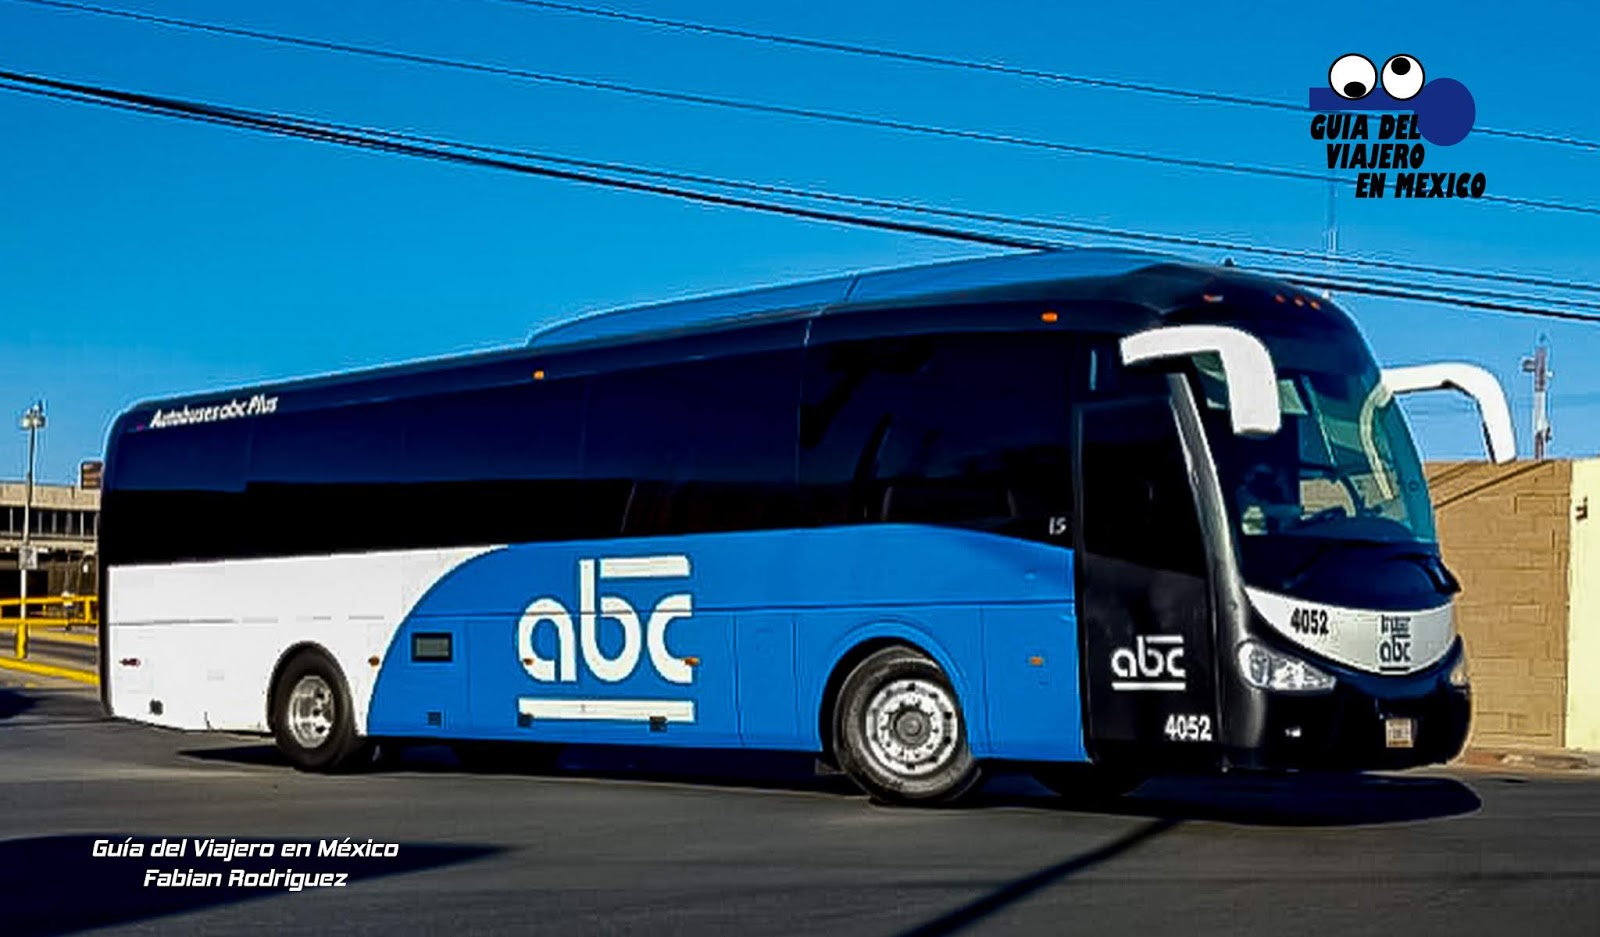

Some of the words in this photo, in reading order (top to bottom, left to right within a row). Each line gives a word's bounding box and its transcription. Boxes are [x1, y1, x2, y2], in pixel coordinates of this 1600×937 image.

[517, 554, 694, 684] abc
[1291, 607, 1329, 635] 4052
[1111, 635, 1186, 678] abc
[1379, 635, 1411, 662] abc
[1164, 714, 1213, 741] 4052
